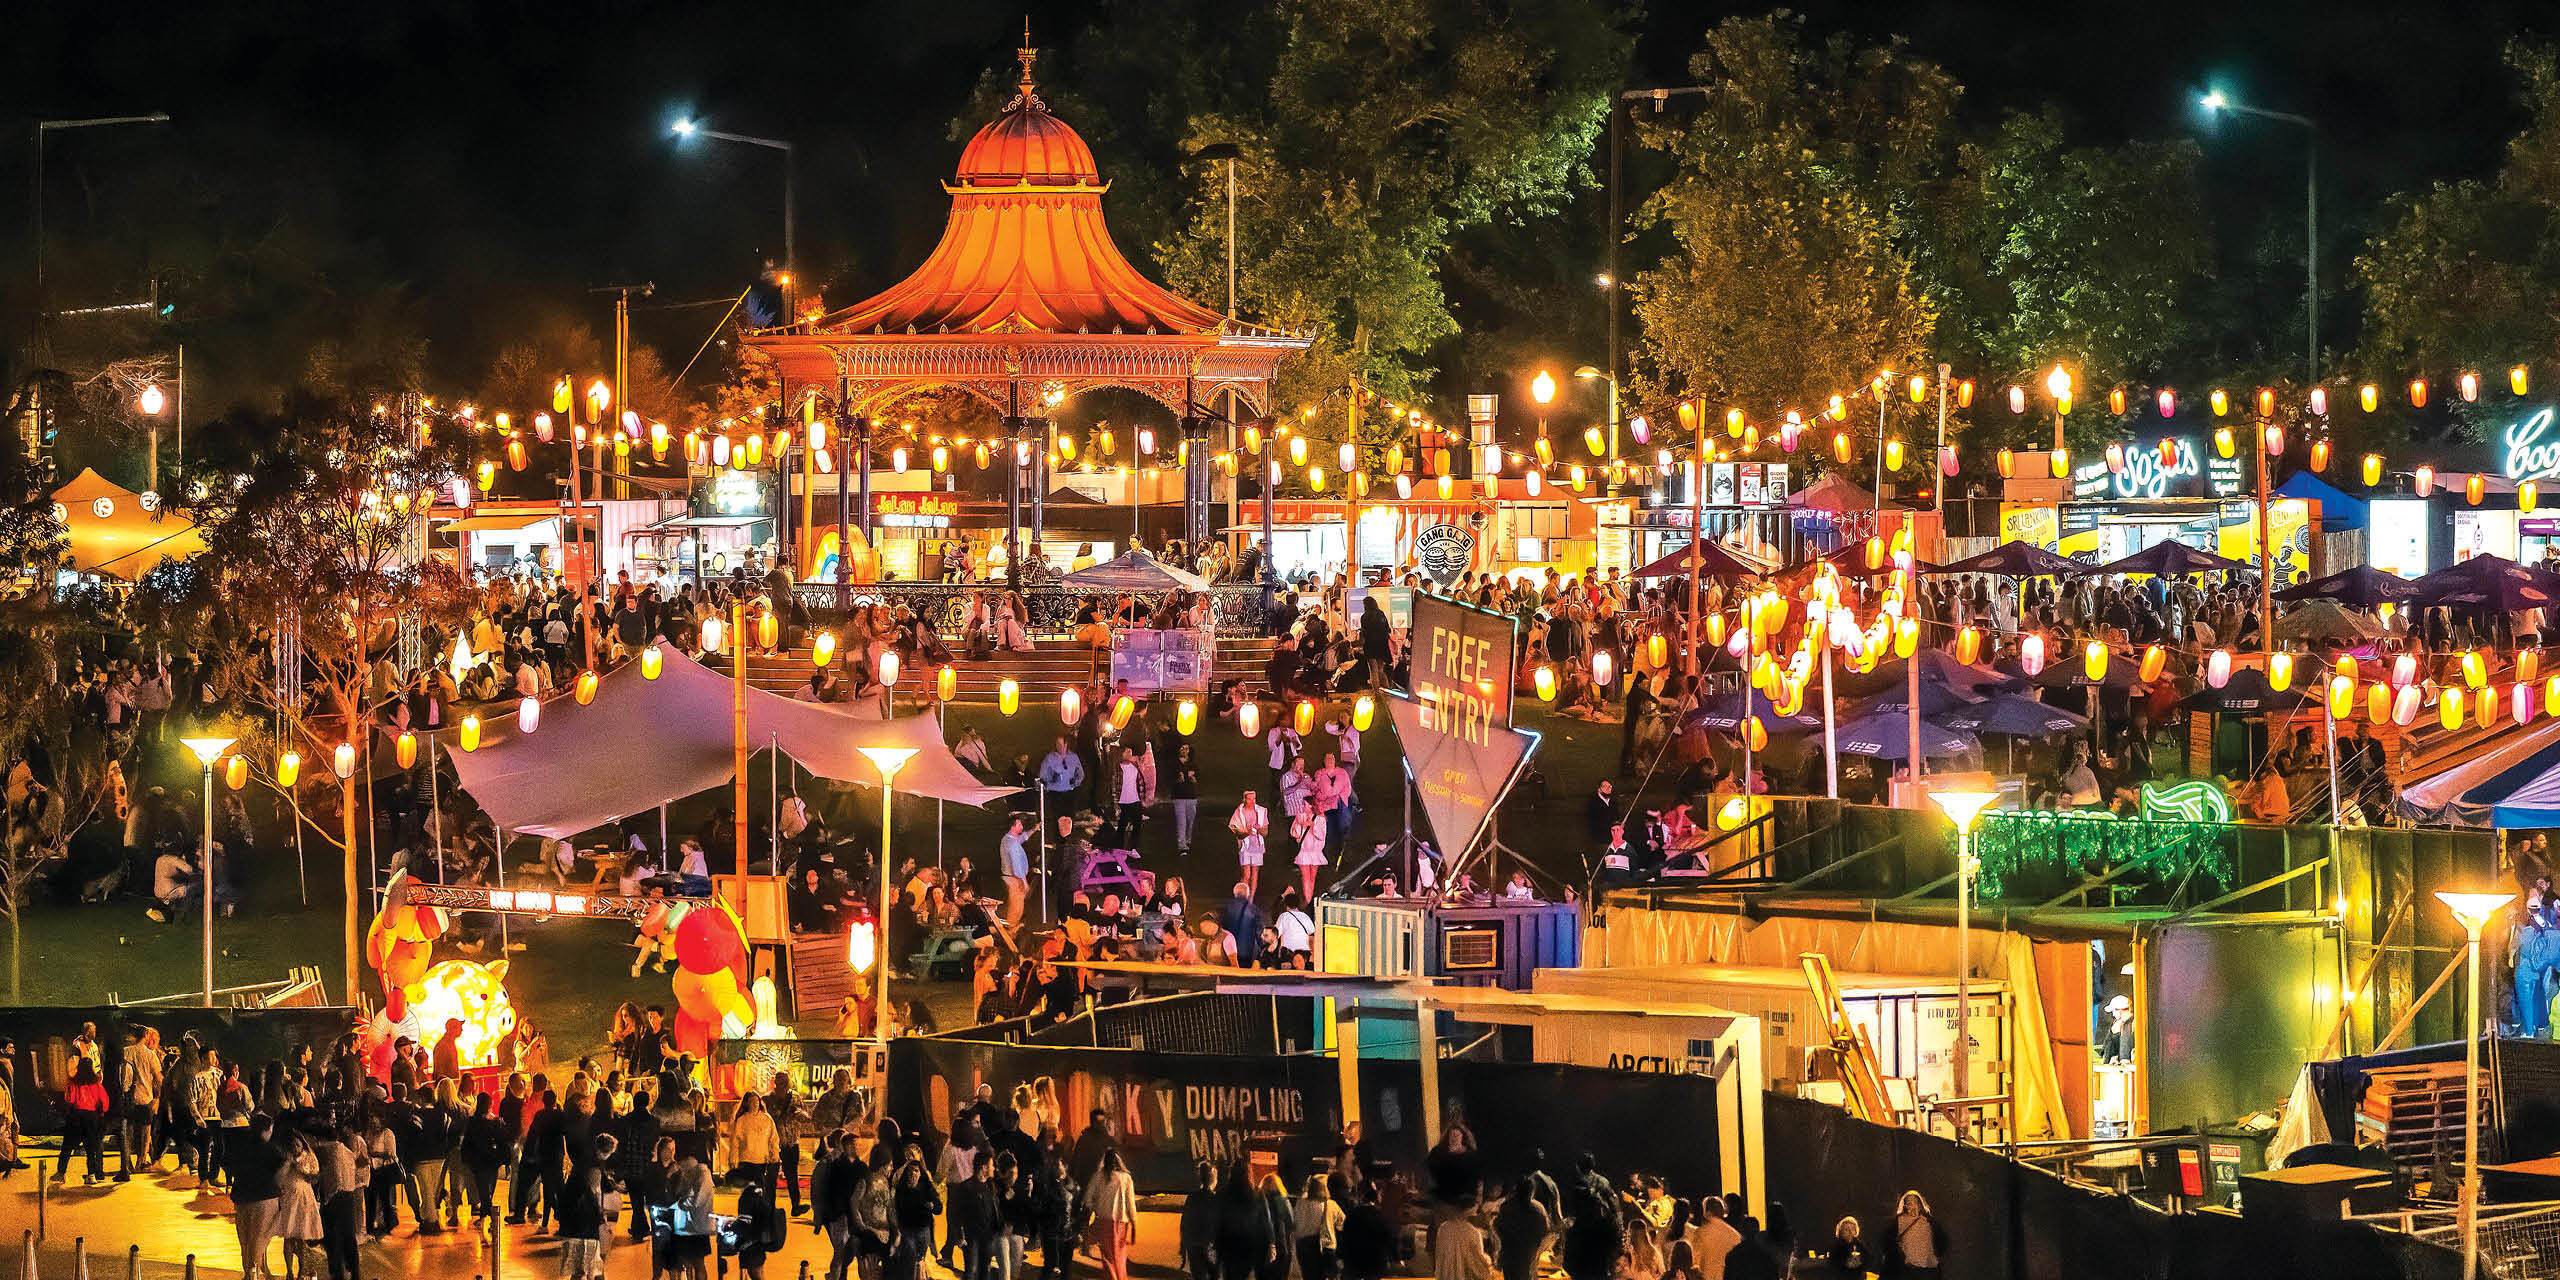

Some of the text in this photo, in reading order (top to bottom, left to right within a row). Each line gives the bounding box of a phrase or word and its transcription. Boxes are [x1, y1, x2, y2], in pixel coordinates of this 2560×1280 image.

[2116, 439, 2198, 499] Soz's
[1421, 528, 1444, 547] GANG
[1431, 626, 1491, 683] FREE
[1416, 681, 1495, 747] ENTRY
[1186, 1085, 1304, 1122] DUMPLING
